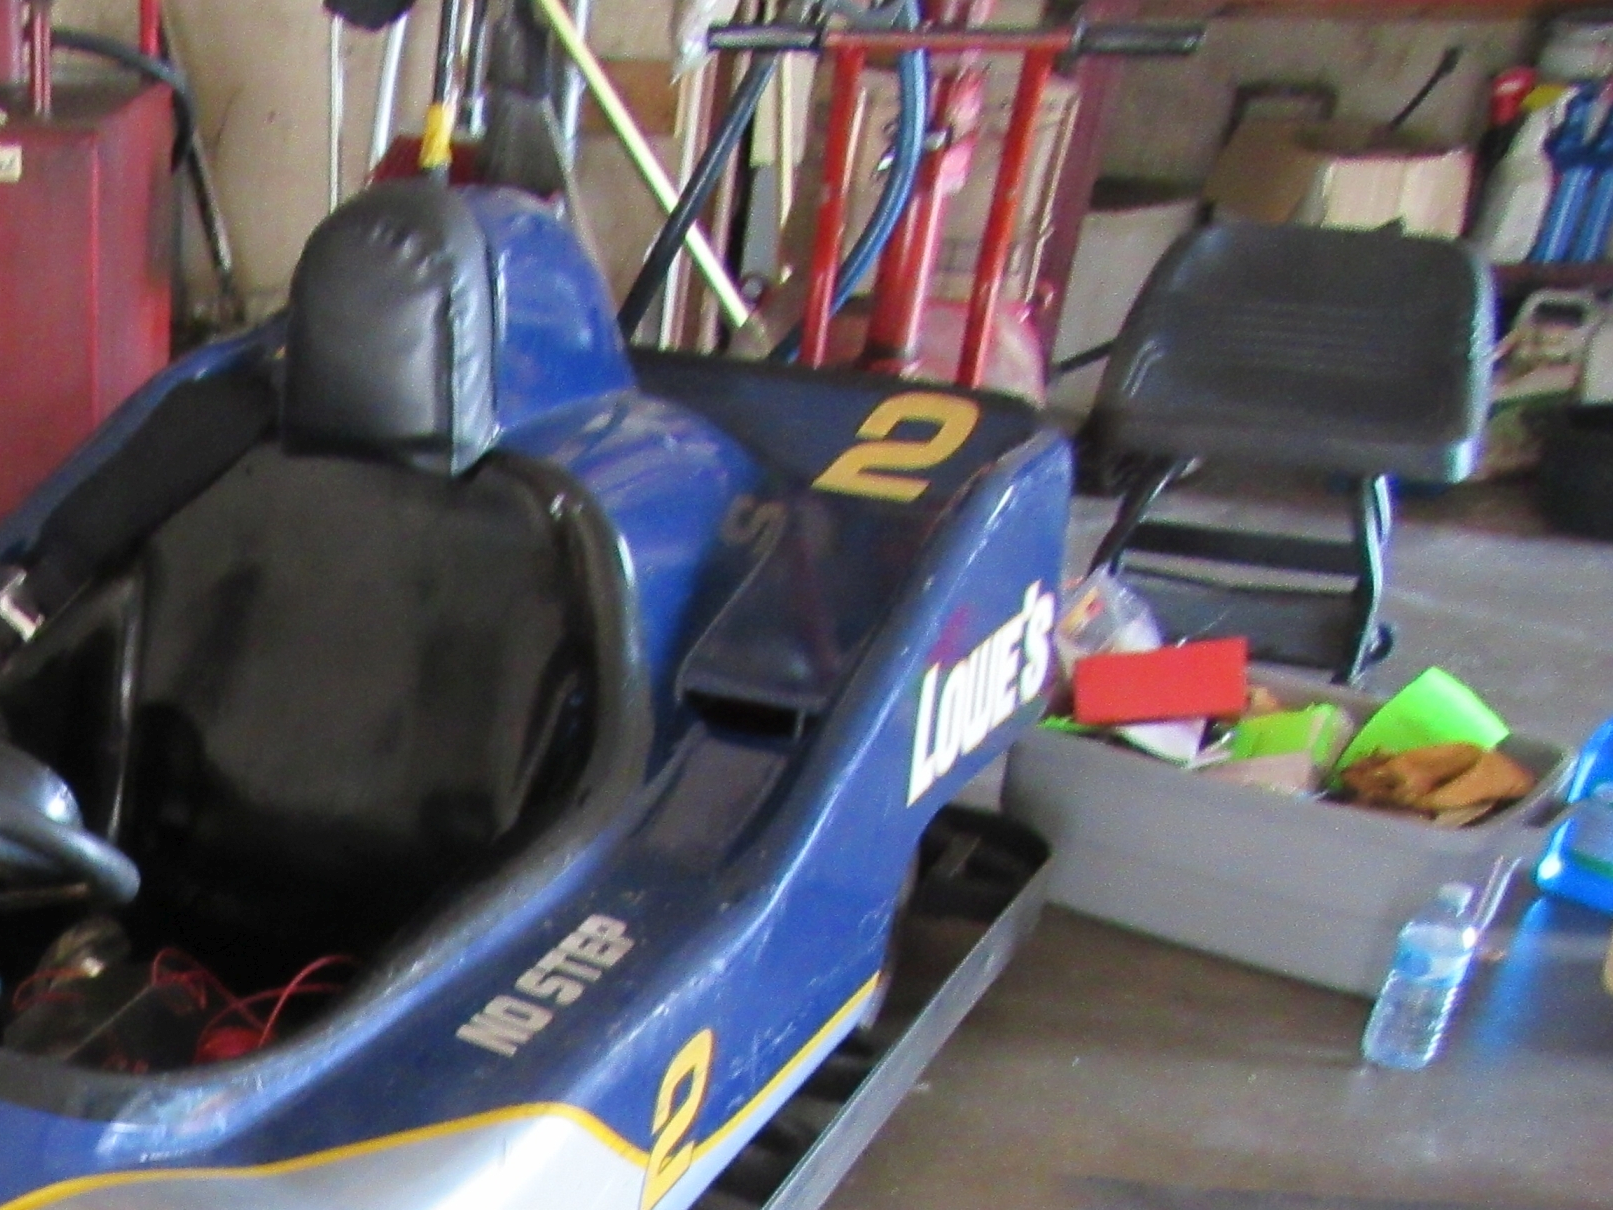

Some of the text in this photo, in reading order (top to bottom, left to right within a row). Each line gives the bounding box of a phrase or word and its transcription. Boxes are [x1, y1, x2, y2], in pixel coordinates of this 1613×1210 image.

[811, 390, 981, 503] 2
[455, 913, 637, 1058] NO STEP
